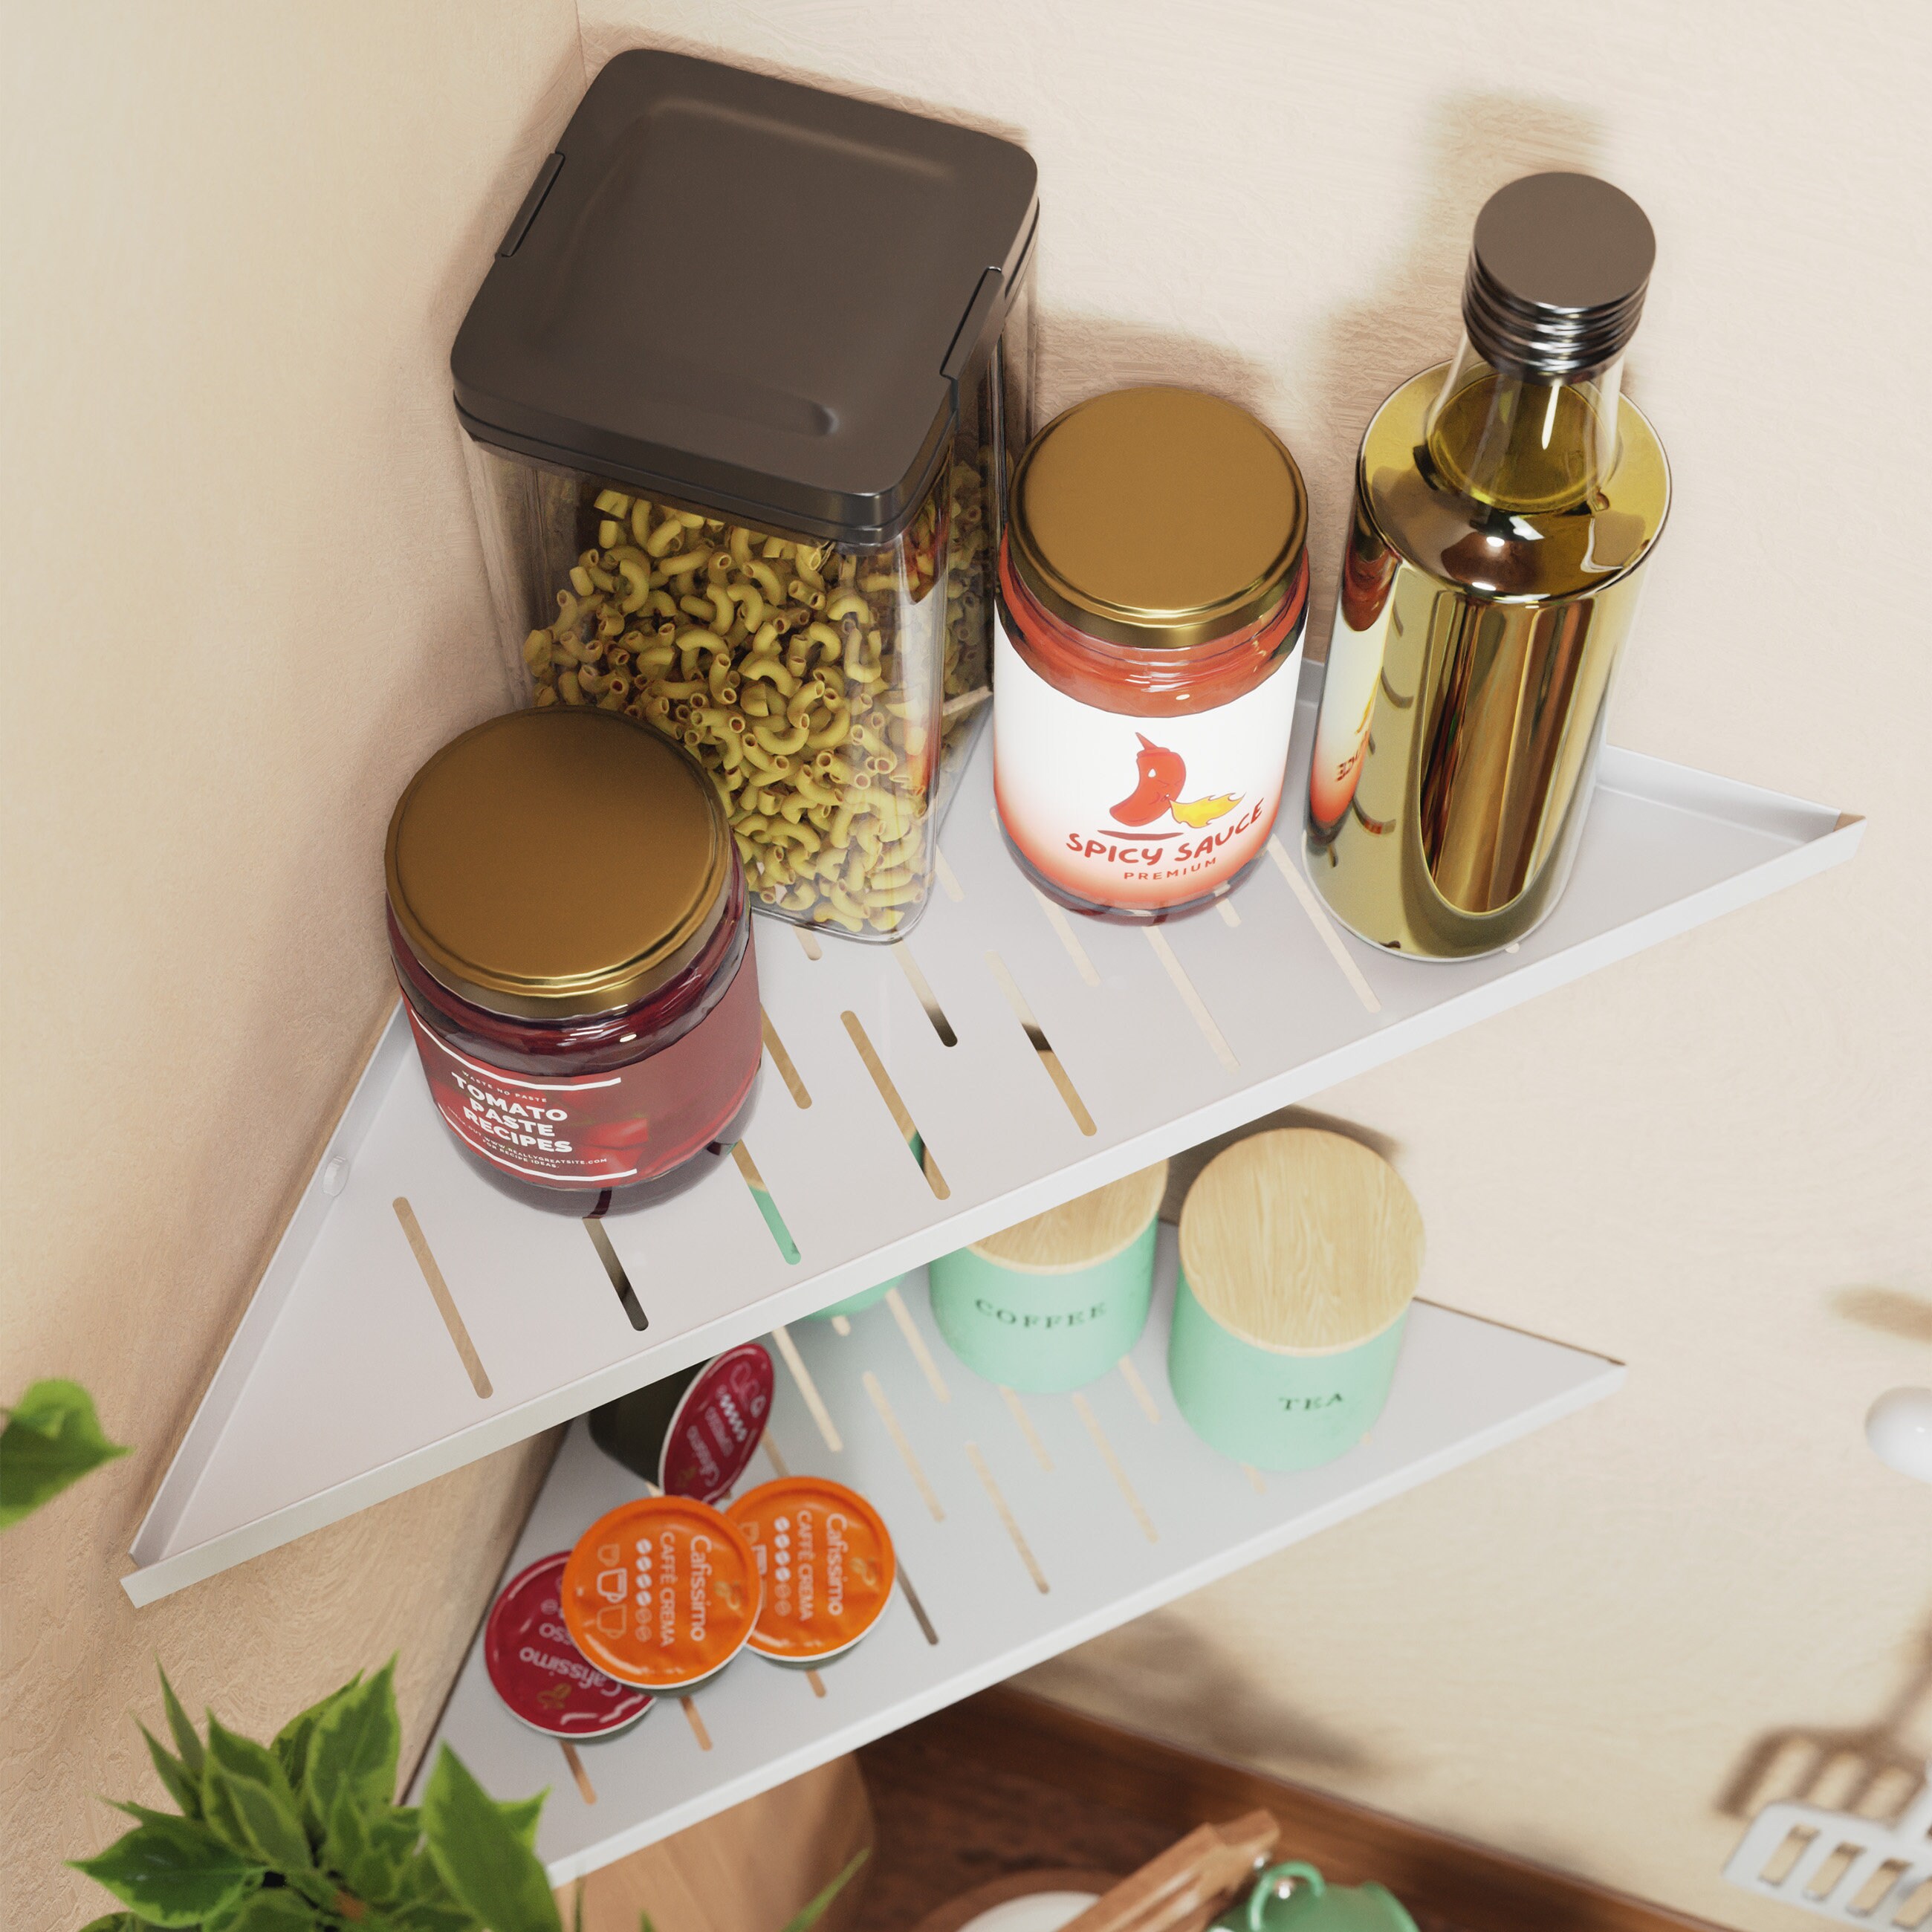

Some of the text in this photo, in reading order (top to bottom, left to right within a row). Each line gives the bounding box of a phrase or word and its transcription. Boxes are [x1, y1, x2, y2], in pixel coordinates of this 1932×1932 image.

[1066, 797, 1264, 866] SPICY SAUCE
[1124, 857, 1216, 881] PREMIUM
[451, 1072, 568, 1121] TOMATO
[462, 1070, 548, 1103] WASTE NO PASTE
[463, 1106, 573, 1153] RECIPES
[470, 1098, 555, 1137] PASTE
[483, 1138, 497, 1150] FOR
[500, 1147, 528, 1162] RECIPE
[974, 1297, 1109, 1329] COFFEE
[1278, 1392, 1344, 1412] TEA
[826, 1512, 848, 1616] Cafissimo
[690, 1534, 713, 1642] Cafissimo
[797, 1562, 814, 1621] CREMA
[659, 1587, 675, 1647] CREMA
